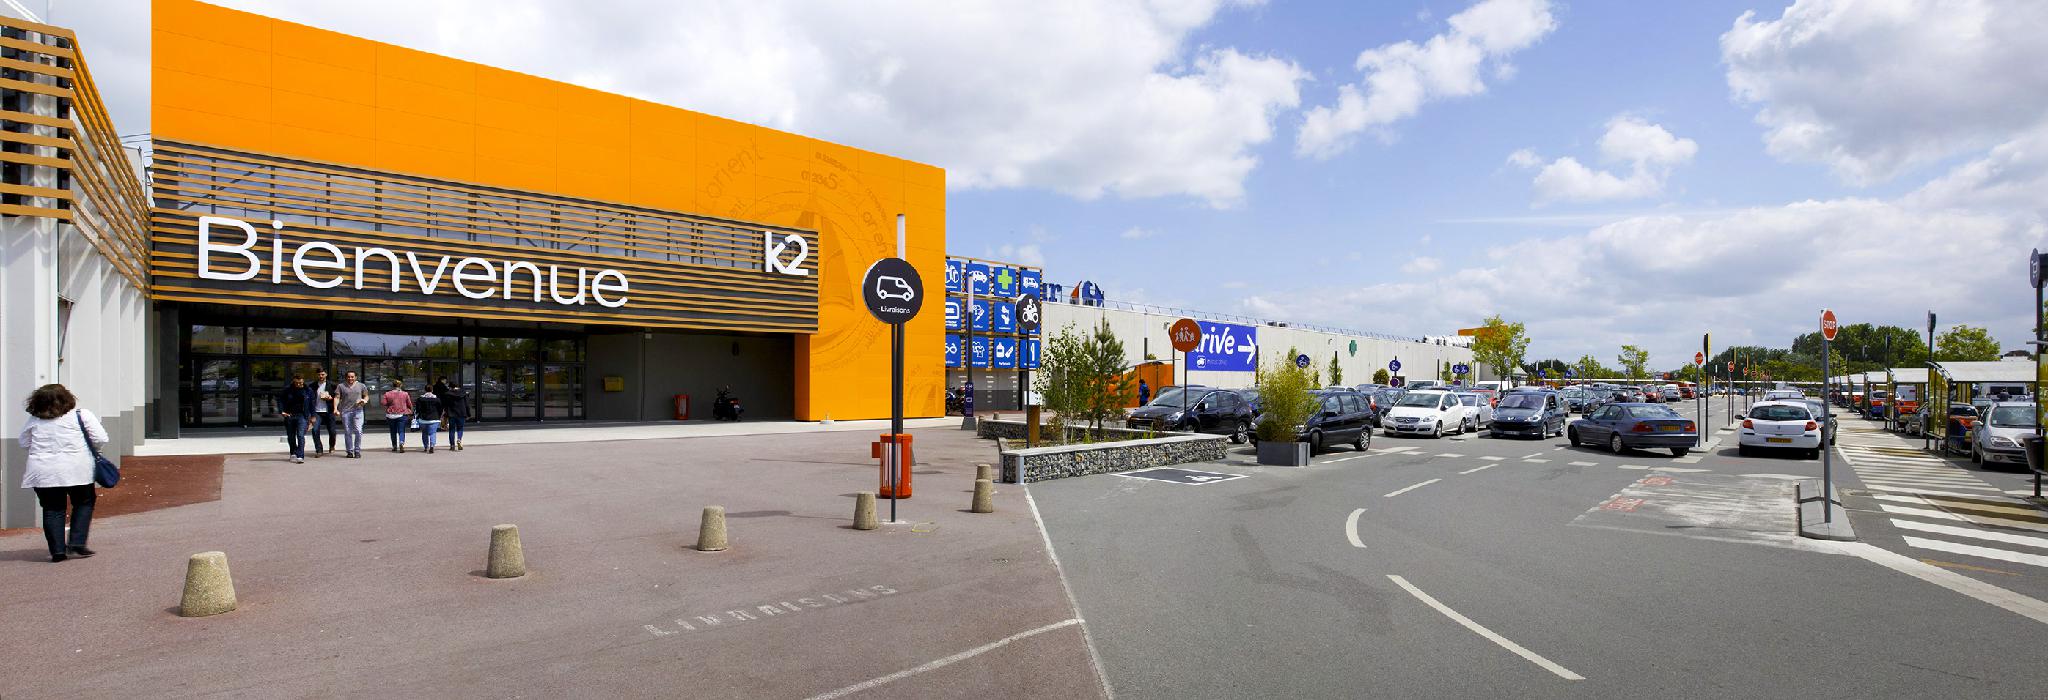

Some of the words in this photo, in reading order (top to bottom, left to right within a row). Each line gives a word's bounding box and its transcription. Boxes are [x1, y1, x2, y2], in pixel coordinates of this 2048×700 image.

[199, 215, 628, 308] Bienvenue
[764, 230, 809, 276] k2
[1193, 326, 1235, 355] rive
